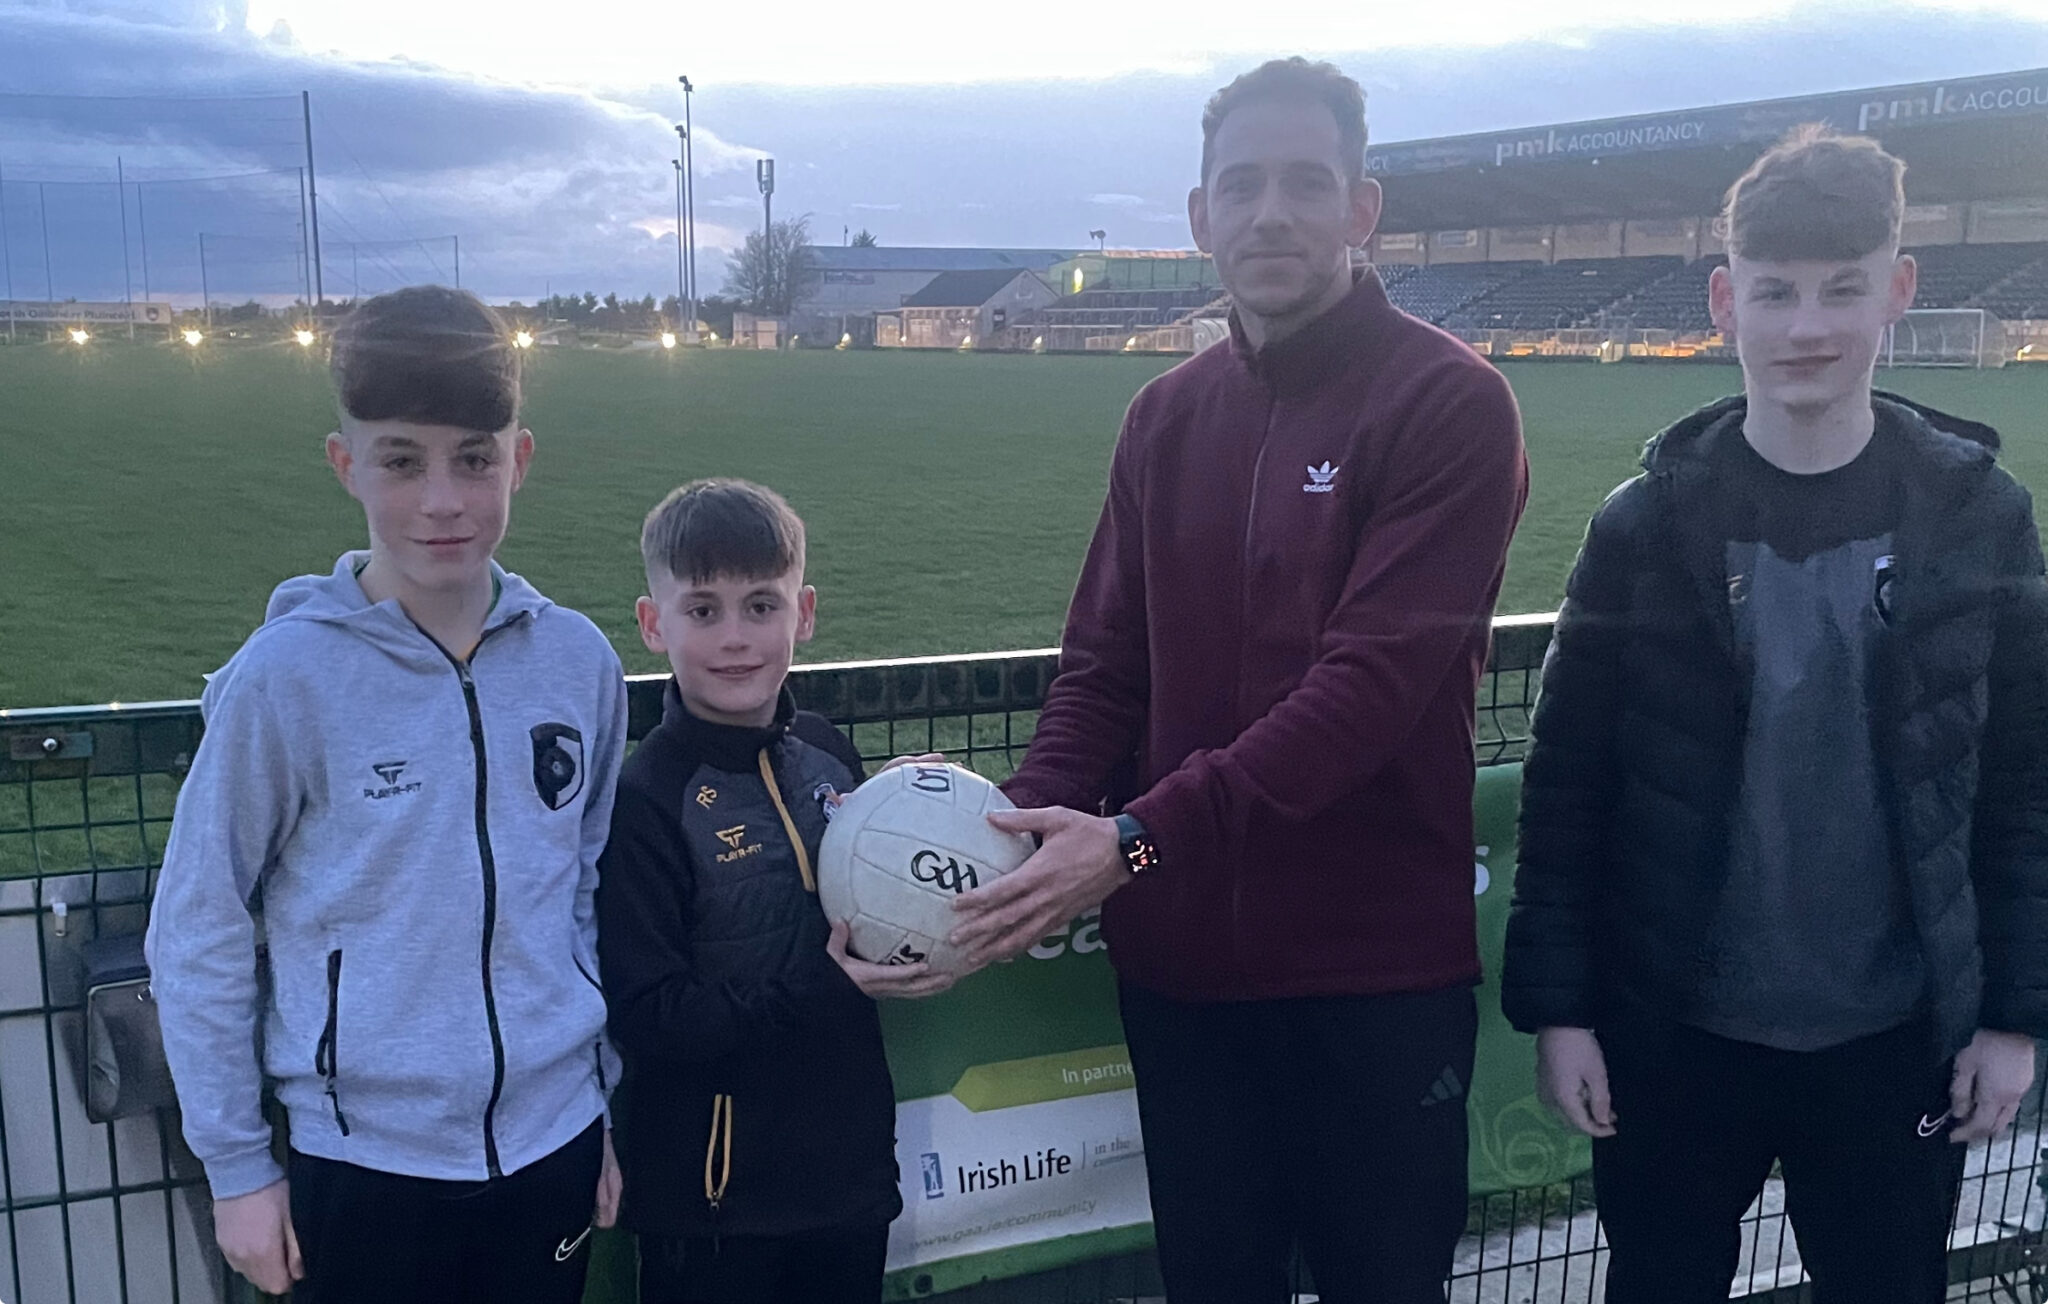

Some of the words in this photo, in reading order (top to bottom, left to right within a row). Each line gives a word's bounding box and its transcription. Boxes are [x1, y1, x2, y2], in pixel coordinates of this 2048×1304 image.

[1858, 87, 1957, 131] pmk
[1495, 130, 1564, 167] pmk
[1567, 121, 1705, 153] ACCOUNTANCY
[696, 785, 718, 810] RS
[1062, 1067, 1080, 1084] In
[957, 1158, 1018, 1195] Irish
[1023, 1147, 1072, 1182] Life
